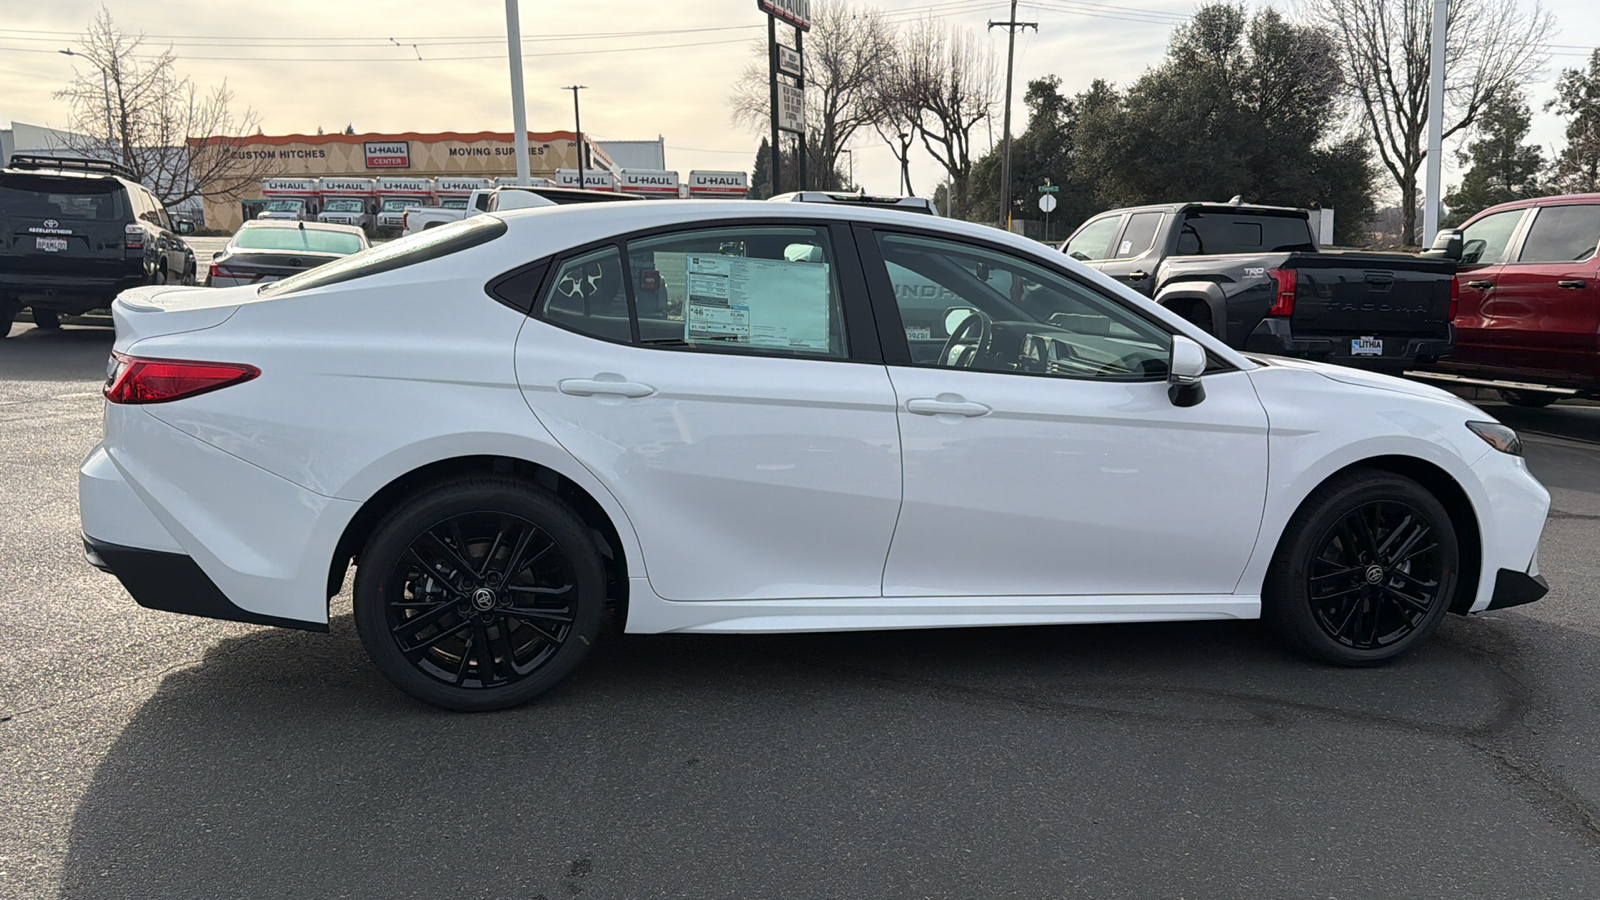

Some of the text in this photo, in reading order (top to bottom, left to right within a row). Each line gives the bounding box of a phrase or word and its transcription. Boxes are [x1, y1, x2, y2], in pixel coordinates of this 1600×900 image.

[231, 149, 326, 160] CUSTOM HITCHES
[368, 146, 405, 154] U-HAUL
[449, 146, 544, 157] MOVING SUPIES
[373, 157, 402, 165] CENTER
[628, 176, 673, 185] U-HAUL
[696, 175, 742, 186] U-HAUL
[268, 182, 307, 190] U-HAUL
[1323, 302, 1428, 314] TACOMA
[1359, 340, 1382, 348] LITHIA
